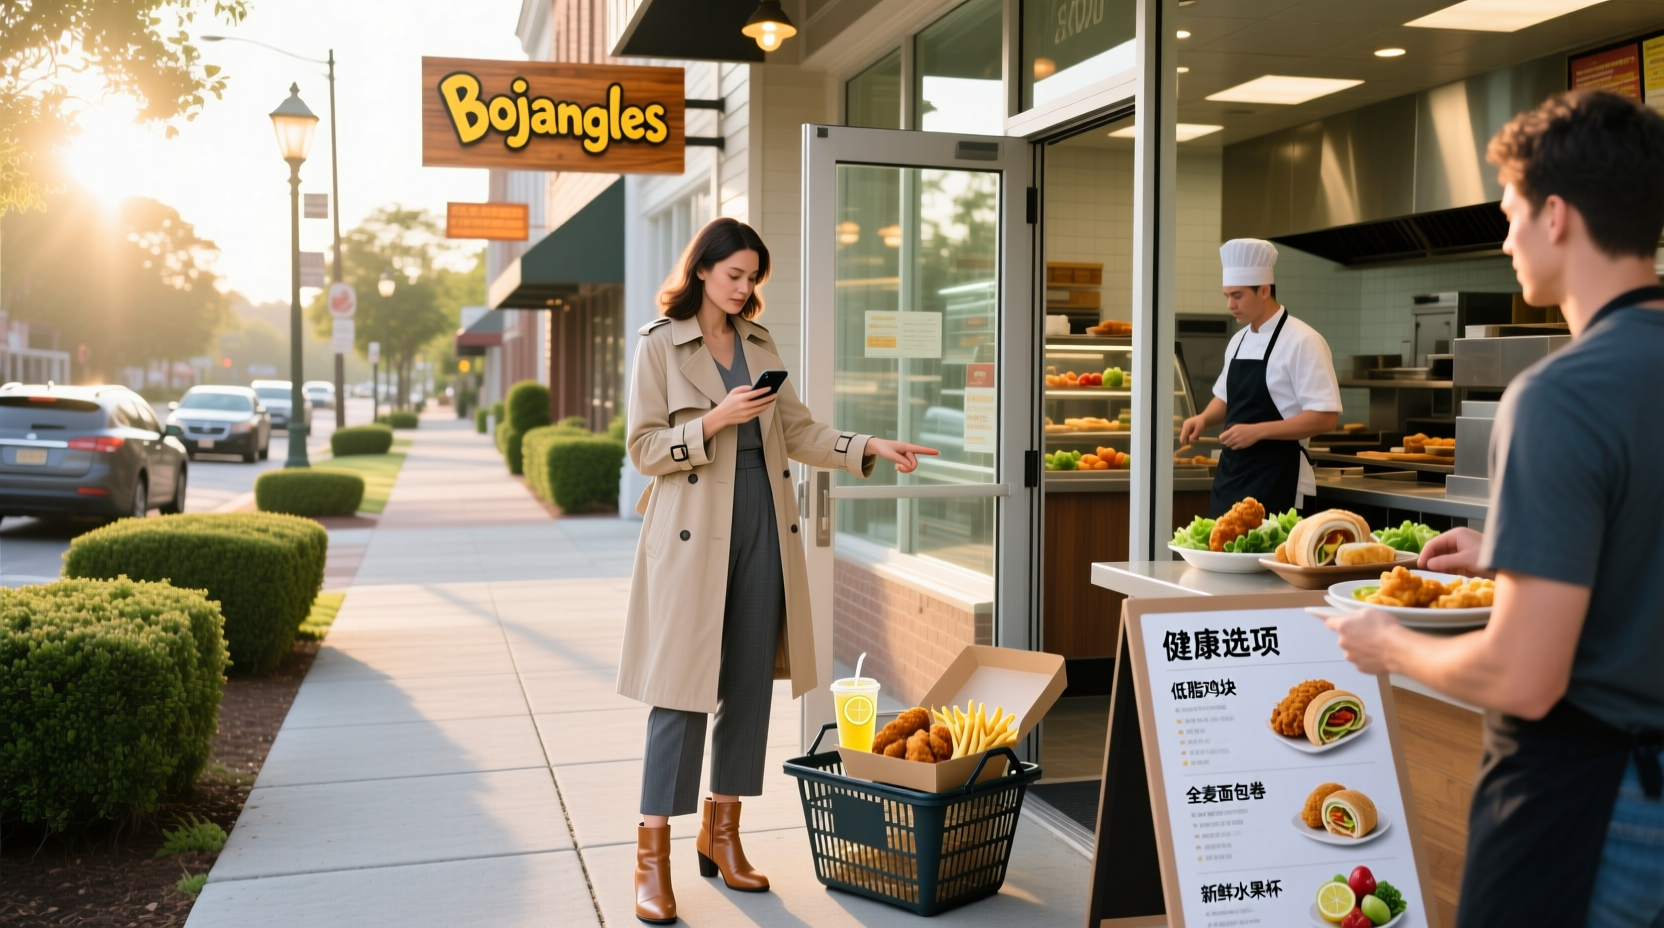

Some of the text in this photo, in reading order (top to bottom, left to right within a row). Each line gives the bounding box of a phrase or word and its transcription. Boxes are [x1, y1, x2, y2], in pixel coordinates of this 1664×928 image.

[439, 72, 669, 155] Bojangles
[1163, 626, 1280, 662] 健康选项
[1171, 678, 1237, 700] 低脂鸡块
[1186, 781, 1266, 804] 全麦面包卷
[1201, 879, 1283, 904] 新鲜水果杯
